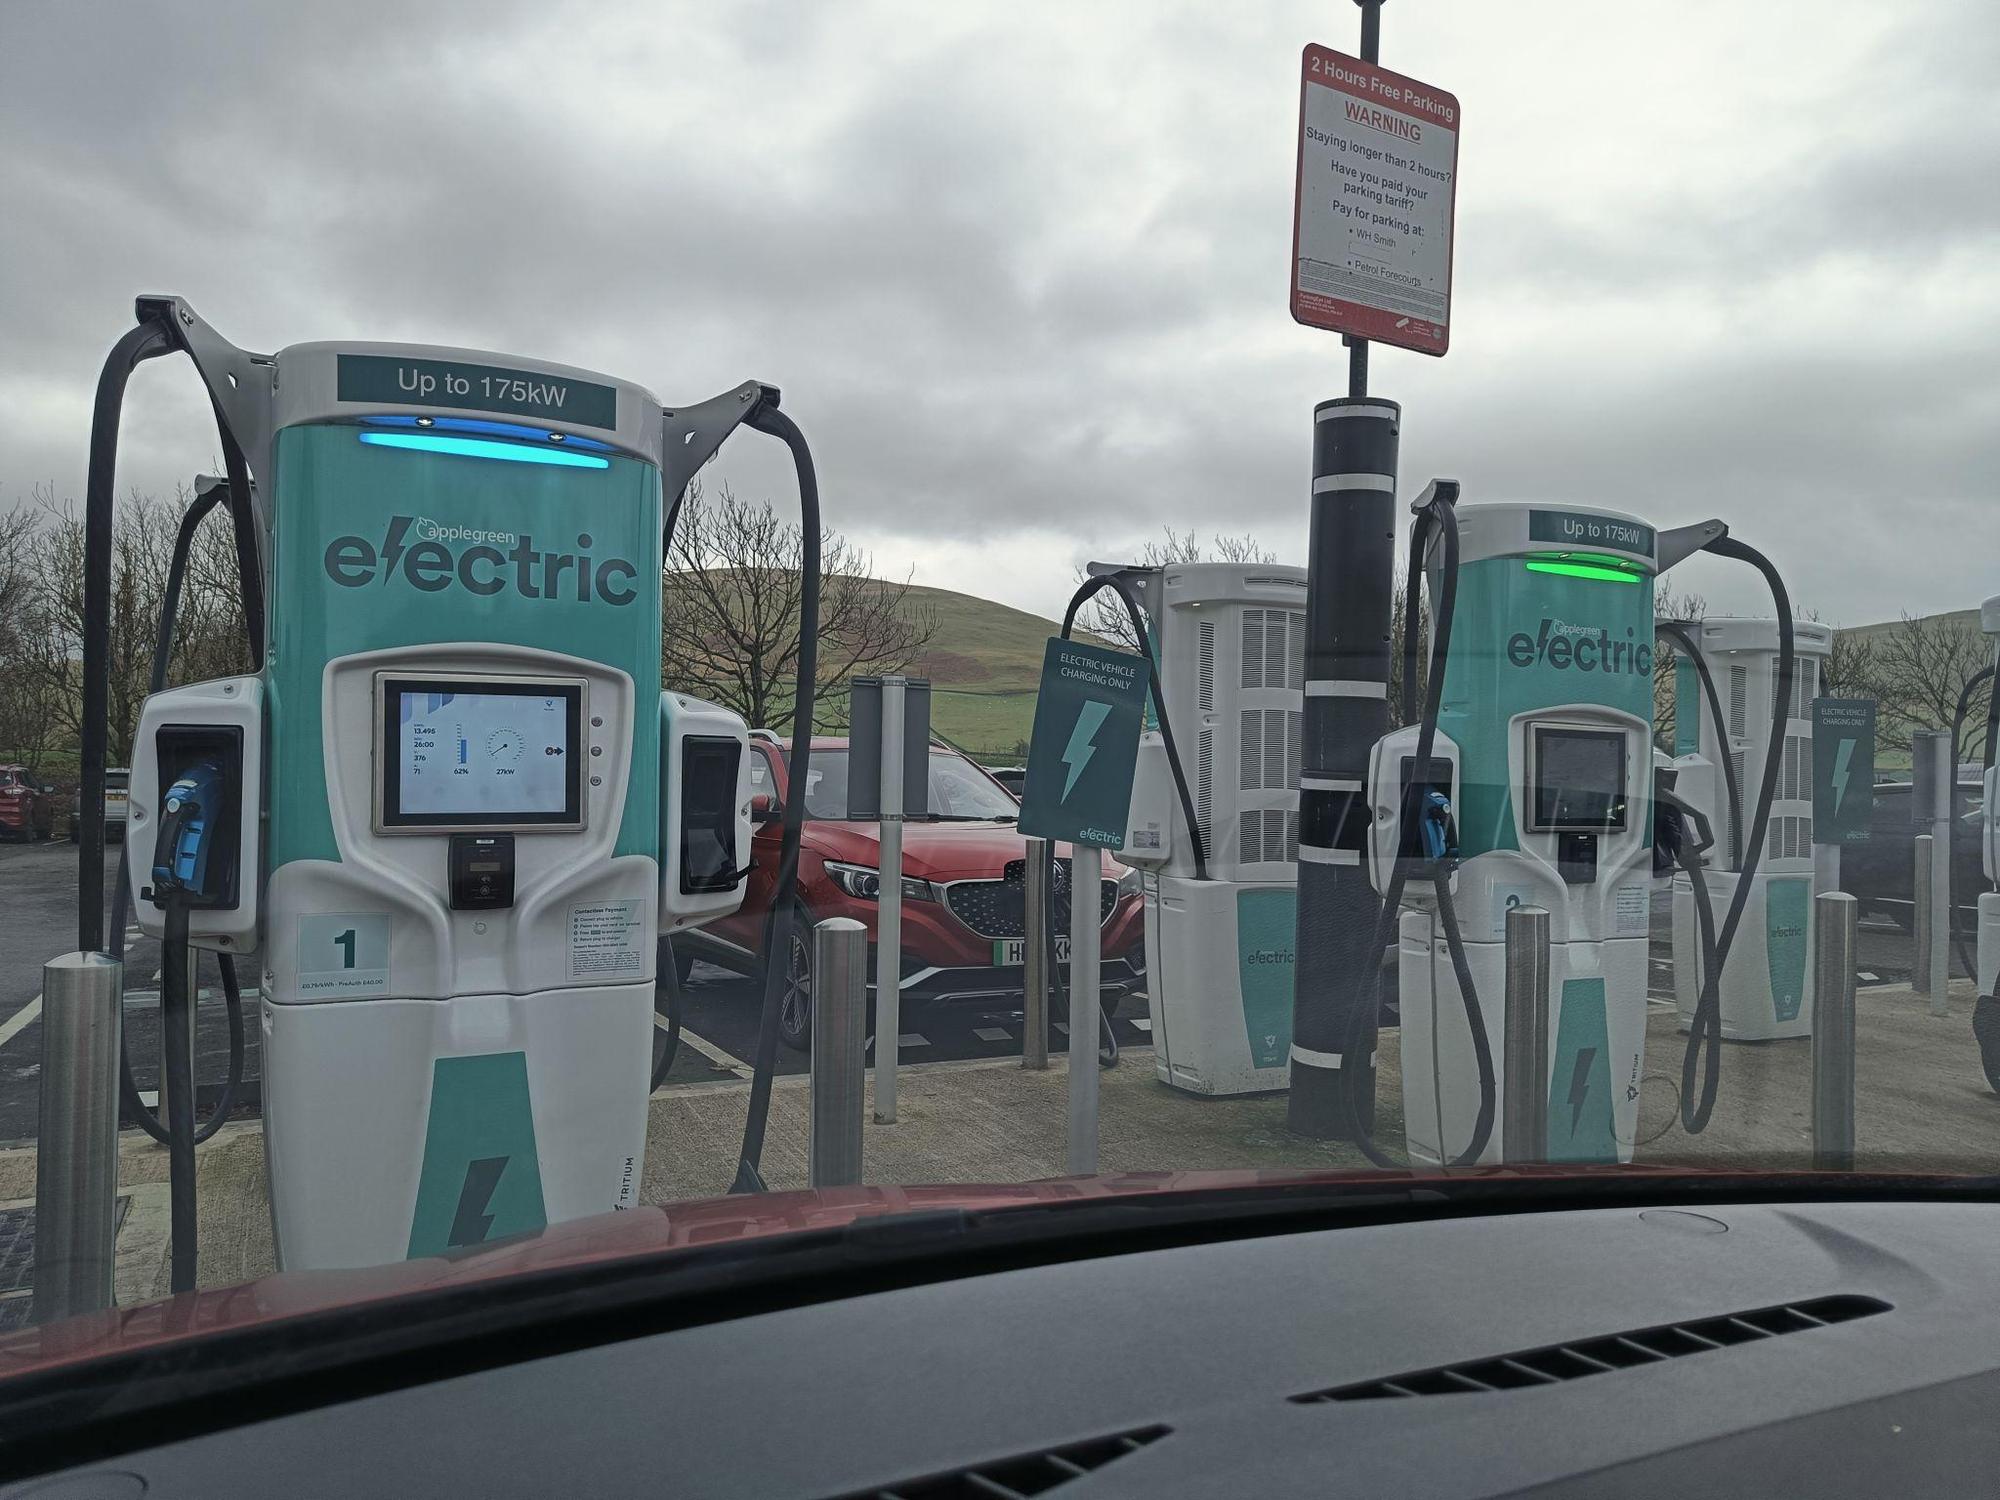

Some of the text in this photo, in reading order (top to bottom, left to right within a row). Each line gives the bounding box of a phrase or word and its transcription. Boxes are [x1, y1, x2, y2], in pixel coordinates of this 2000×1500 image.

[1311, 56, 1454, 123] 2 Hours Free Parking
[1345, 100, 1421, 141] WARNING
[1306, 126, 1452, 183] Staying longer than 2 hours?
[1331, 159, 1429, 200] Have you paid your
[1343, 183, 1415, 211] parking tariff?
[1332, 200, 1425, 237] Pay for parking at:
[1356, 228, 1397, 248] WH Smith
[1354, 260, 1379, 275] Petrol
[398, 367, 568, 408] Up to 175kW
[422, 519, 515, 546] applegreen
[1563, 519, 1640, 545] Up to 175kW
[323, 515, 639, 607] electric
[1060, 652, 1136, 679] ELECTRIC VEHICLE
[1060, 667, 1132, 691] CHARGING ONLY
[413, 754, 427, 762] 376
[334, 929, 356, 969] 1
[1247, 949, 1295, 965] electric
[620, 1157, 634, 1201] TRITIUM
